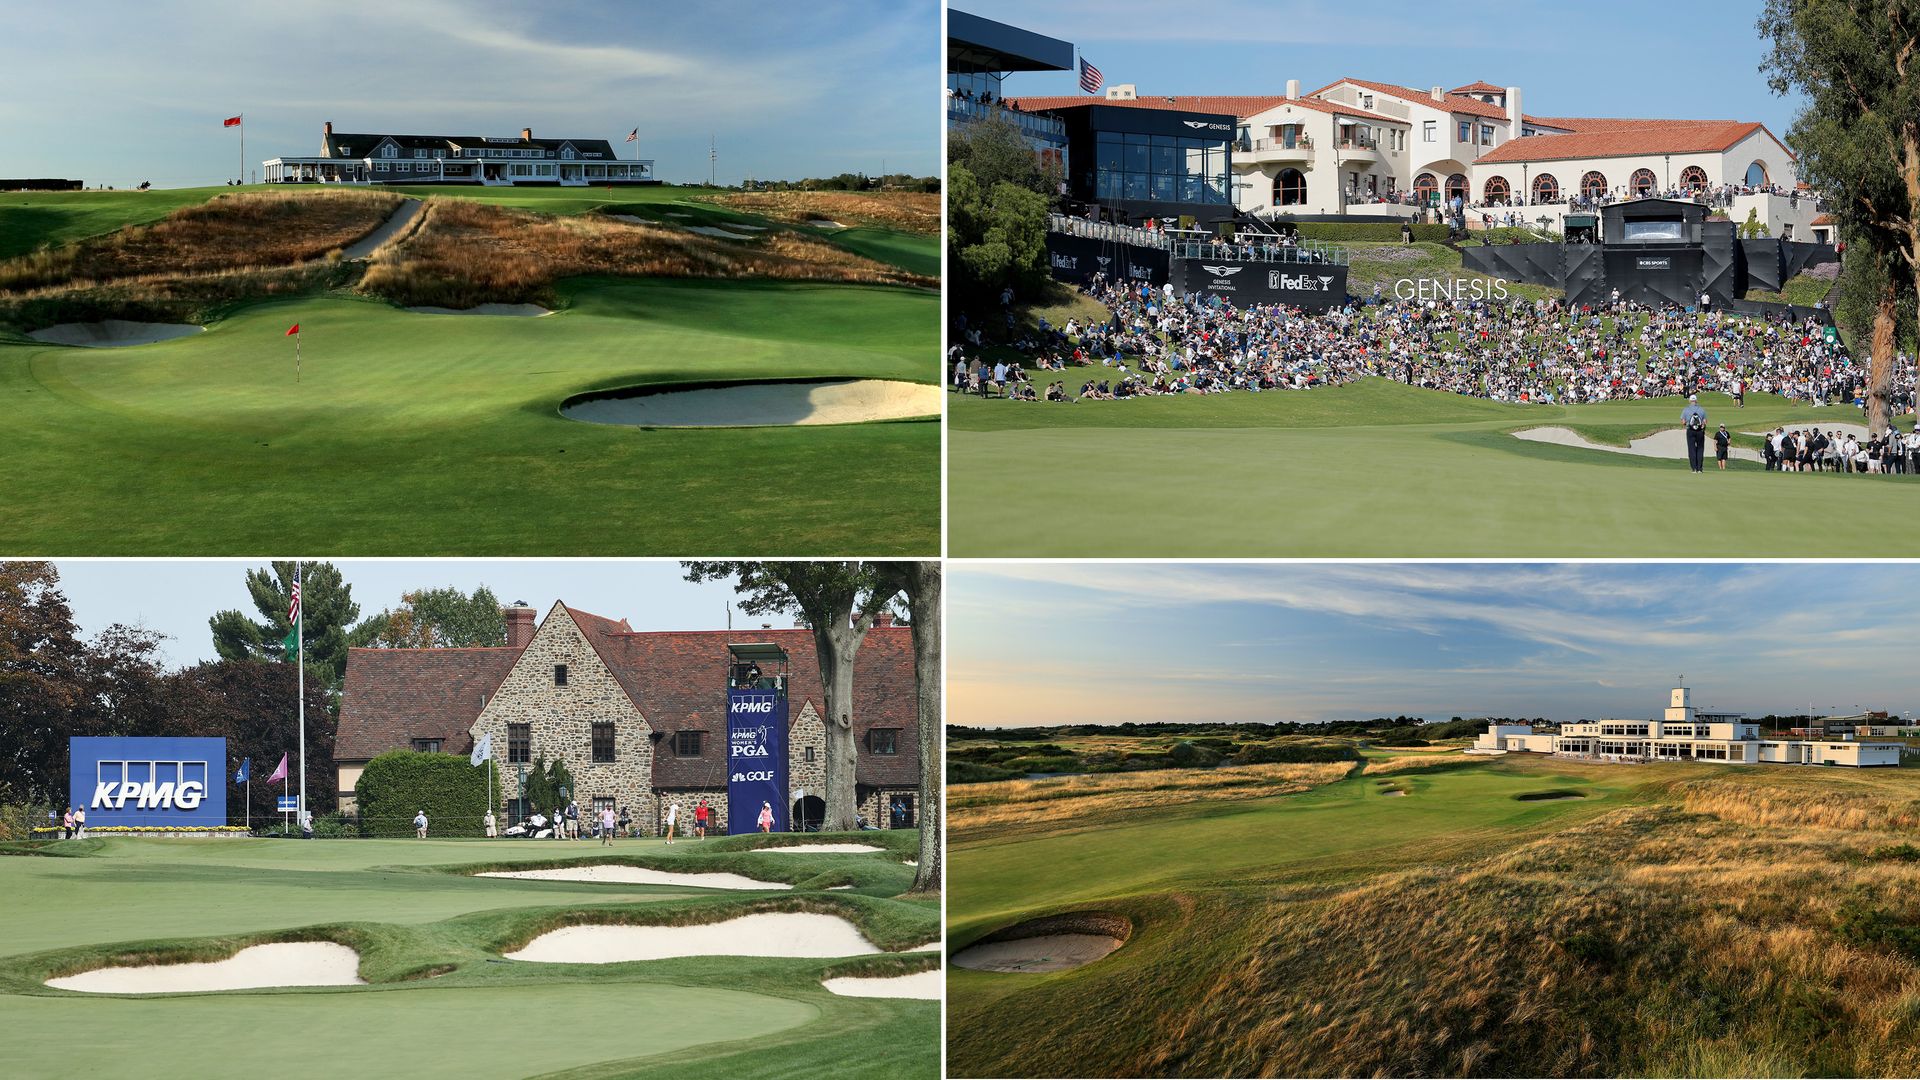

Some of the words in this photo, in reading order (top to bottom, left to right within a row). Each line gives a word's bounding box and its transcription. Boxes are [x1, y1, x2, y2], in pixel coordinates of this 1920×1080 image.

[1208, 123, 1231, 131] GENESIS
[1207, 284, 1237, 292] INVITATIONAL
[1212, 278, 1232, 286] GENESIS
[1280, 273, 1318, 291] FedEx
[1395, 278, 1508, 301] GENESIS
[731, 702, 772, 713] KPMG
[731, 744, 769, 757] PGA
[746, 770, 774, 782] GOLF
[91, 780, 203, 810] KPMG
